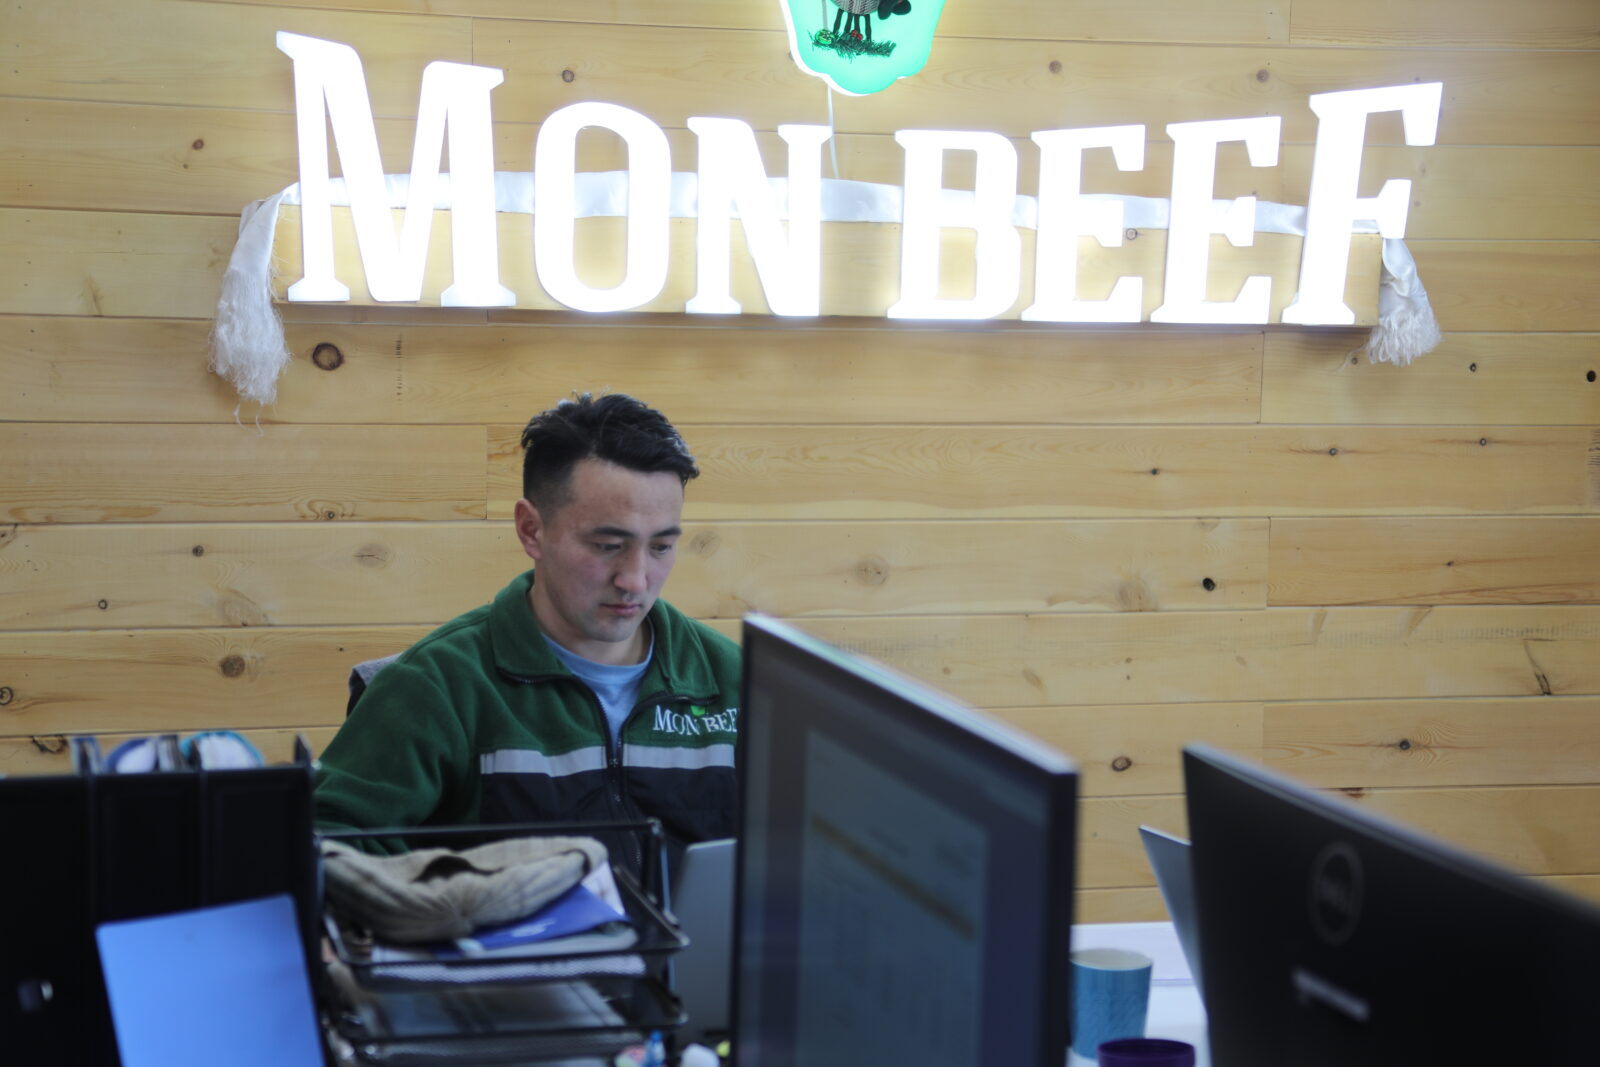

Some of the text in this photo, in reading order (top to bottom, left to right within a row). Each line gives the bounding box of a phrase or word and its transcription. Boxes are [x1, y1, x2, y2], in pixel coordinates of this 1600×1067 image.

[276, 31, 1443, 325] MON BEEF
[653, 704, 700, 735] MON
